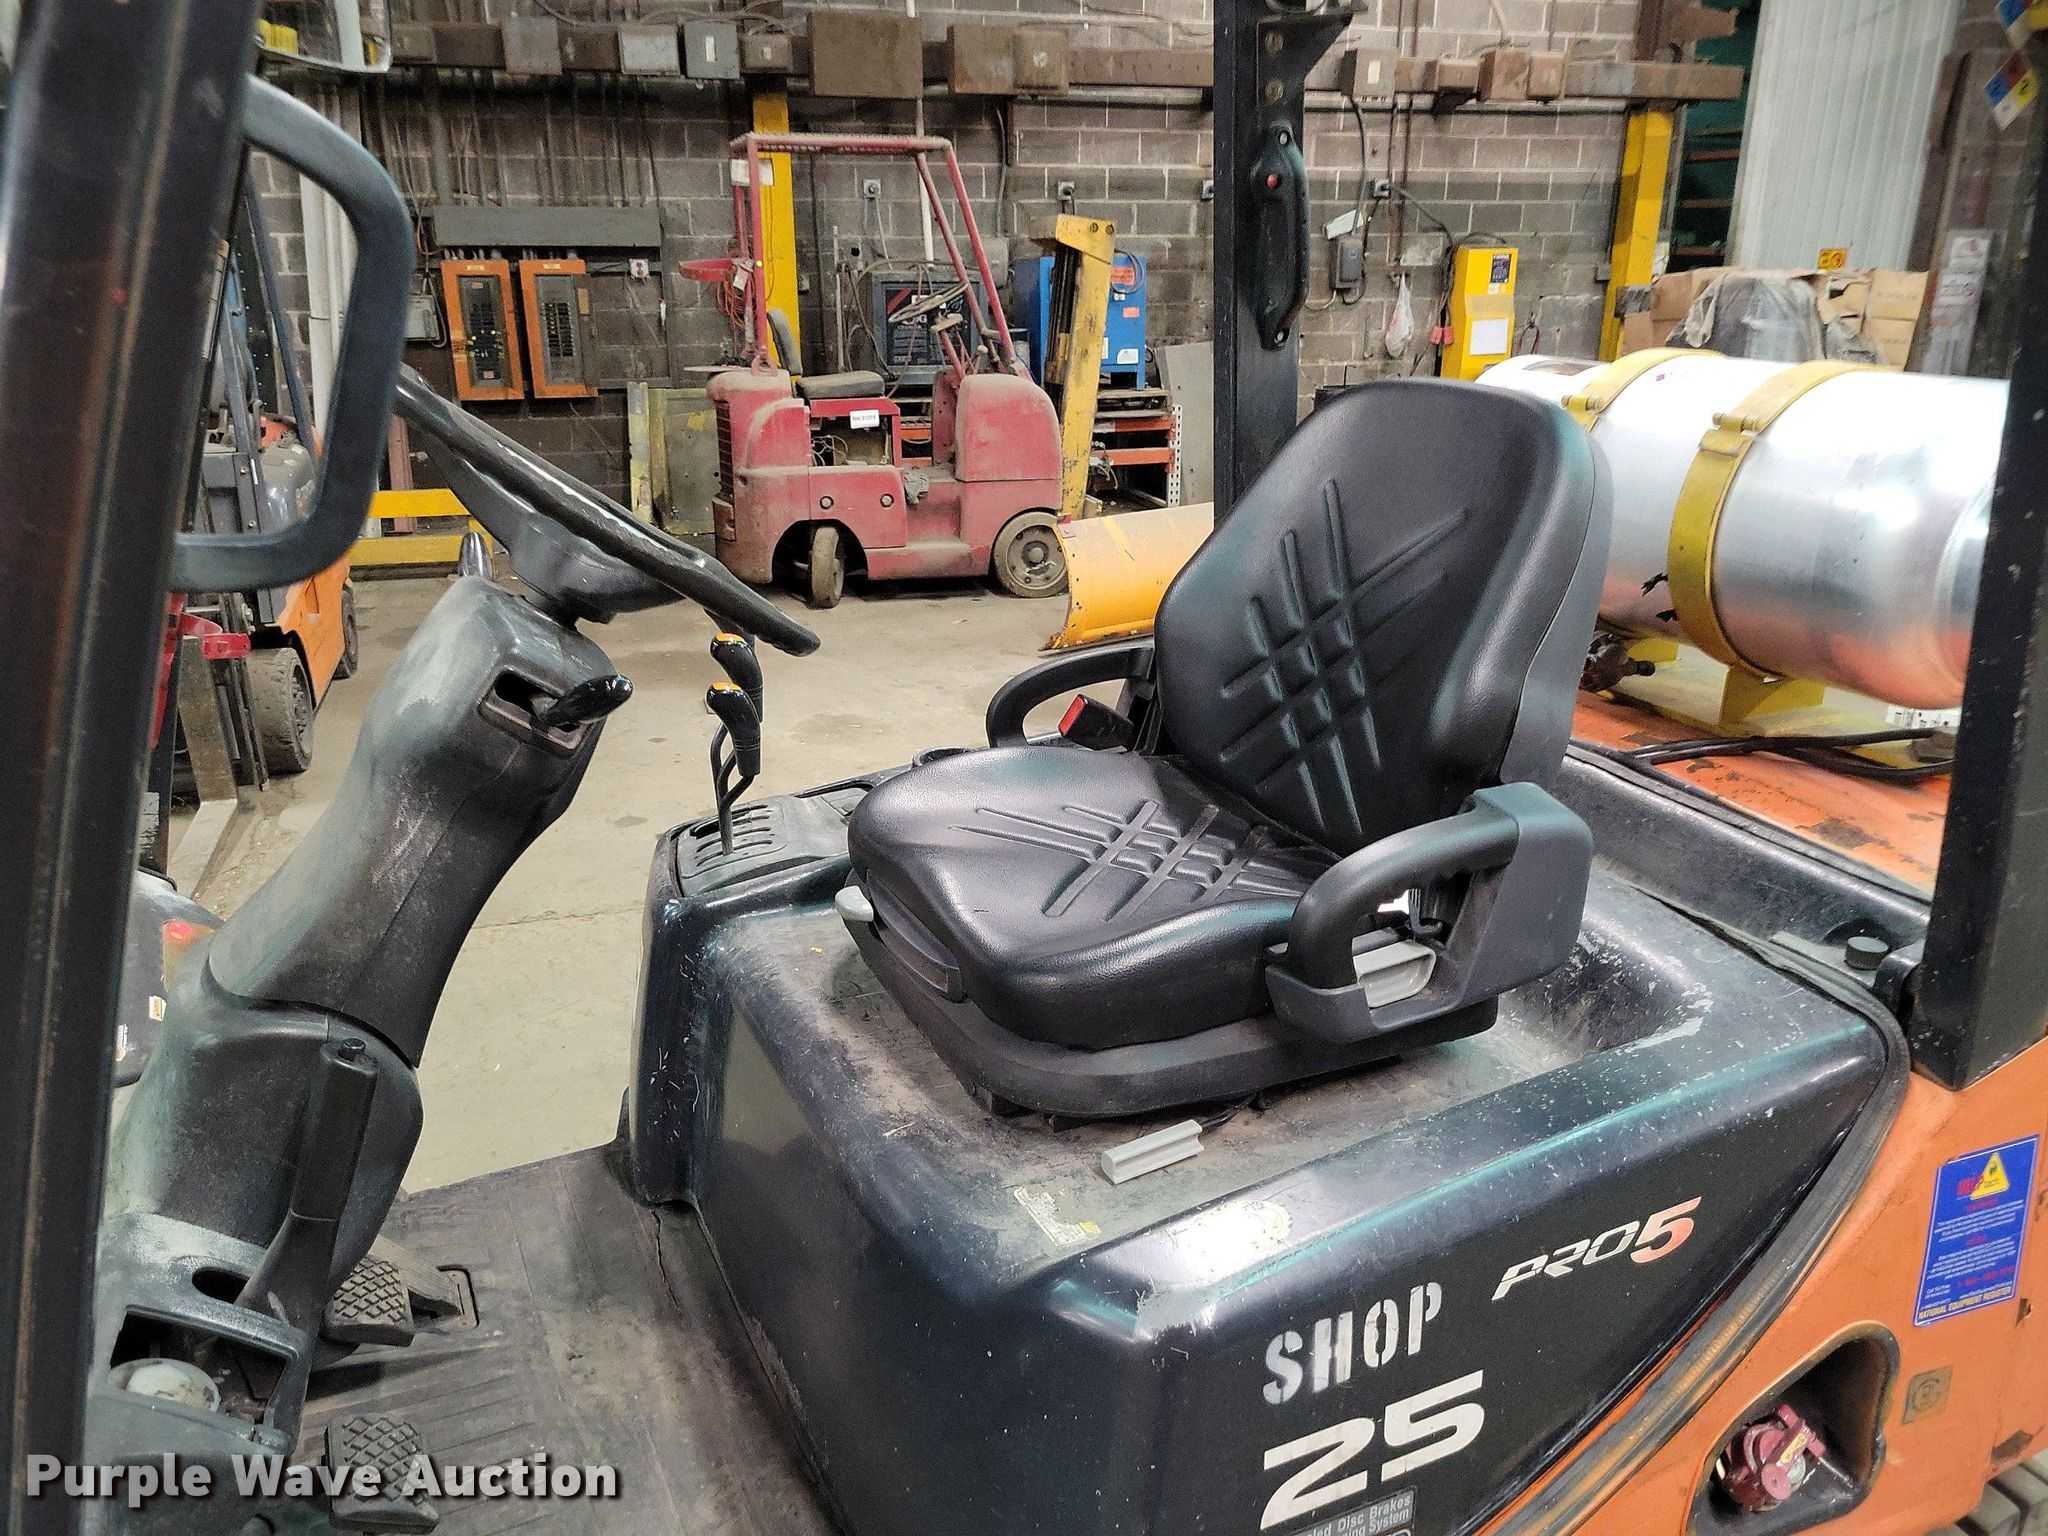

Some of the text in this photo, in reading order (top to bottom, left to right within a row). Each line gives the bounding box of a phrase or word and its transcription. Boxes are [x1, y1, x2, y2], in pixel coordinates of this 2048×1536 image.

[1491, 1196, 1702, 1301] PRO5
[1262, 1282, 1443, 1405] SHOP
[1260, 1370, 1485, 1531] 25
[1337, 1513, 1365, 1532] Disc
[1369, 1495, 1411, 1520] Brakes
[1368, 1508, 1409, 1534] System
